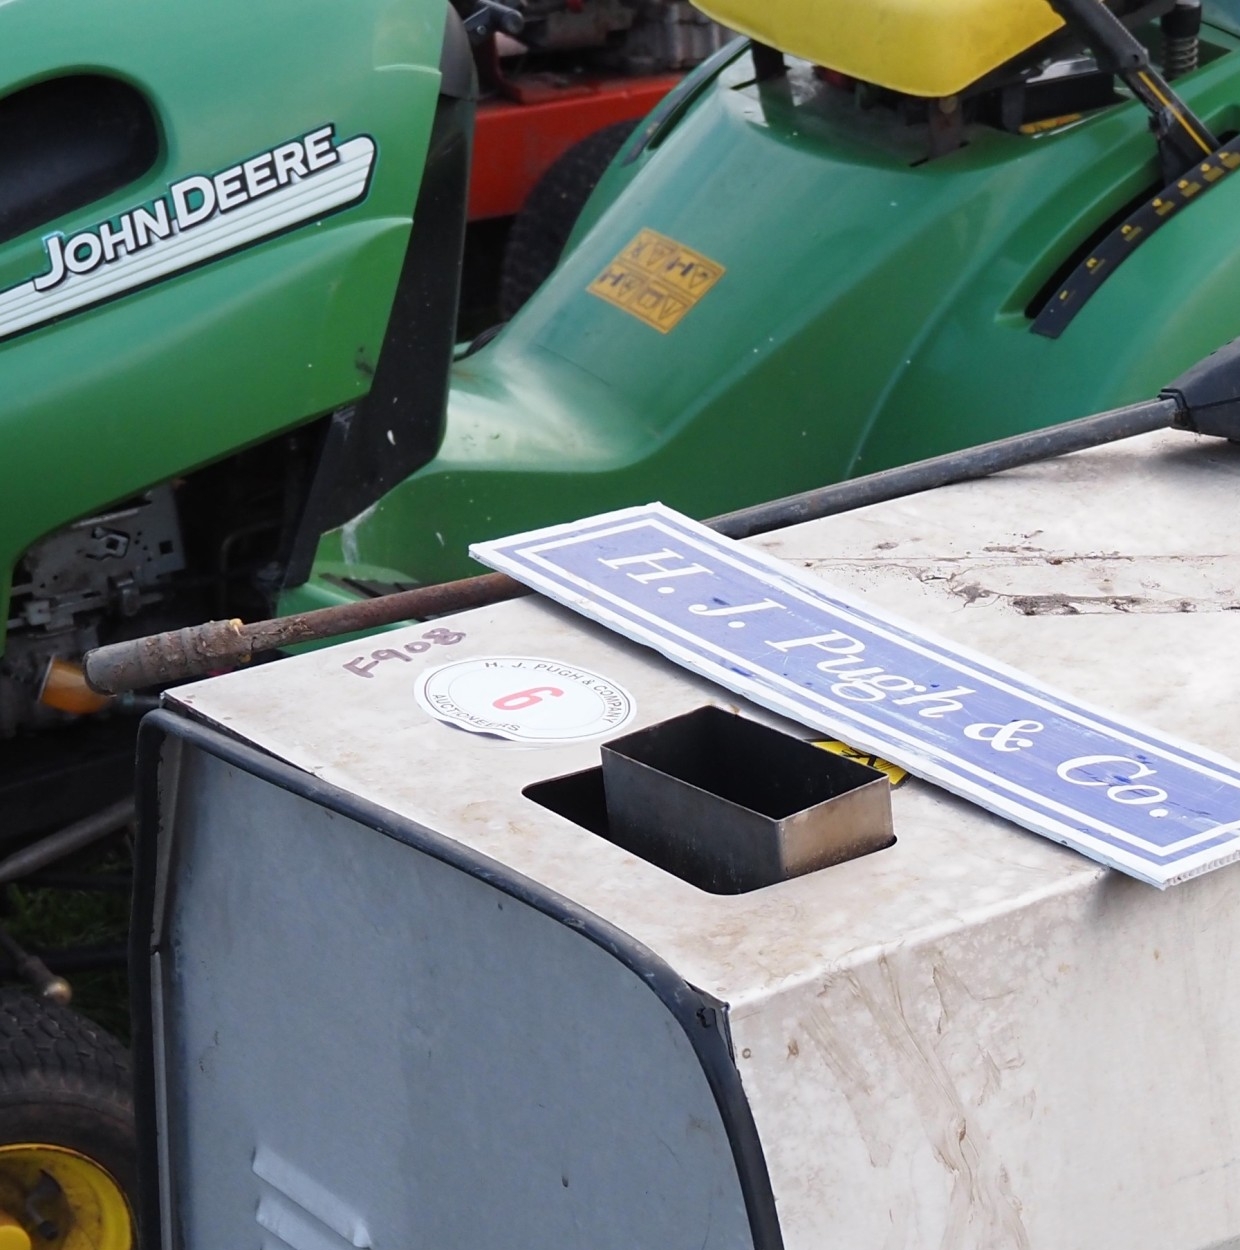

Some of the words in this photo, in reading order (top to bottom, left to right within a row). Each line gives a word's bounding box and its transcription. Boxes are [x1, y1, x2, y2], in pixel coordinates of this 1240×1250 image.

[34, 200, 171, 290] JOHN
[171, 126, 338, 230] DEERE
[342, 627, 467, 679] F908
[598, 548, 713, 594] H.
[688, 598, 787, 629] J.
[764, 629, 977, 718] Pugh
[963, 719, 1045, 752] &
[1056, 754, 1169, 819] Co.
[484, 661, 503, 669] H.
[533, 663, 586, 681] PUGH
[581, 678, 593, 686] &
[593, 684, 621, 725] COMPANY
[492, 686, 565, 711] 6
